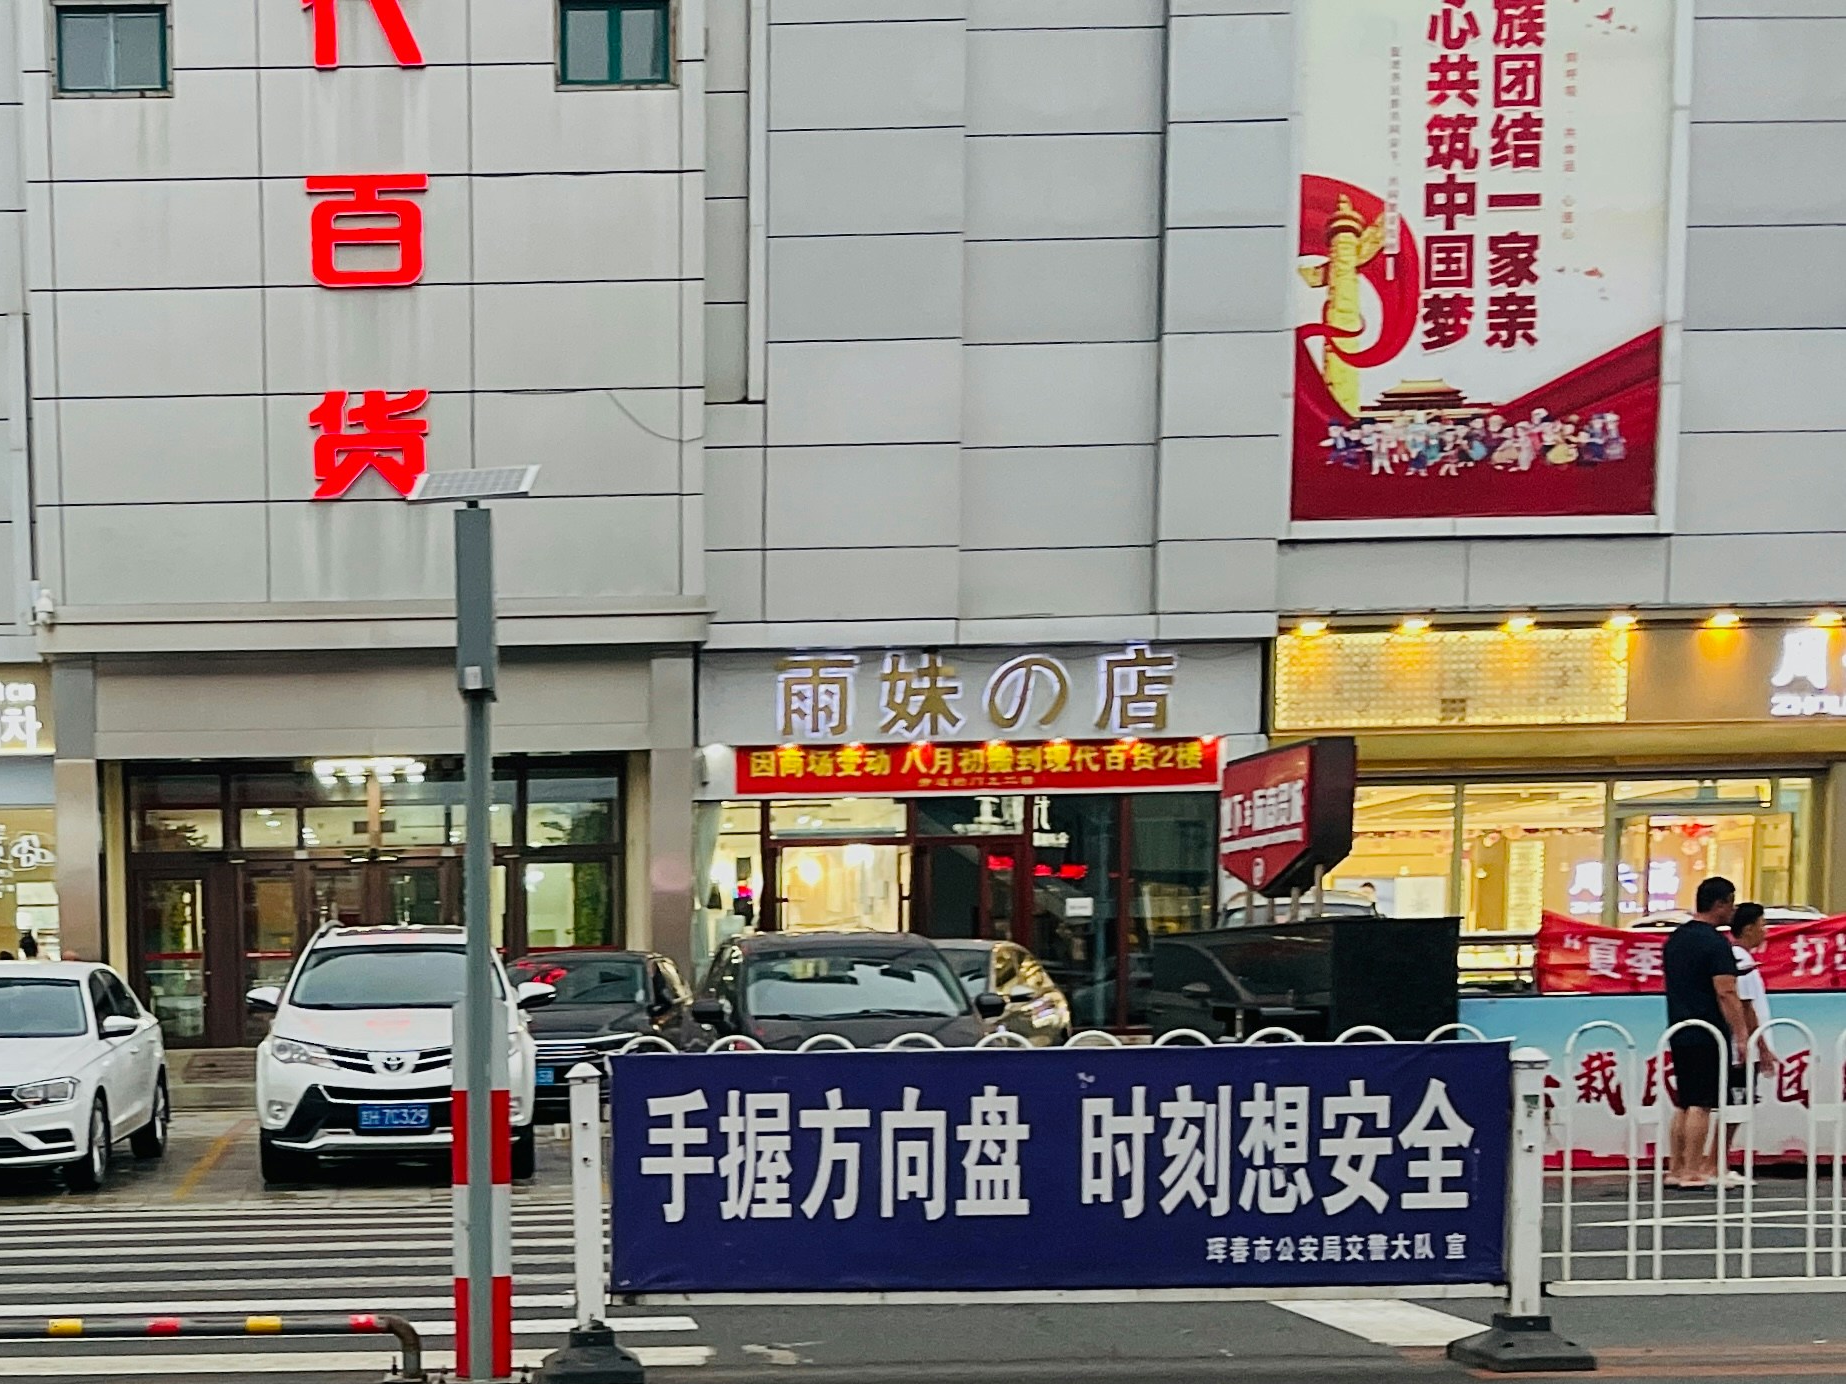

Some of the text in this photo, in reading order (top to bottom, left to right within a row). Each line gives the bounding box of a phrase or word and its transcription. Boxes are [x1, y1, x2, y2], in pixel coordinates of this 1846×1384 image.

[773, 640, 1179, 738] 雨妹の店
[749, 741, 1203, 778] 因商场变动 八月初搬到现代百货2楼
[640, 1076, 1475, 1223] 手握方向盘 时刻想安全
[1205, 1232, 1467, 1263] 珲春市公安局交警大队 宣
